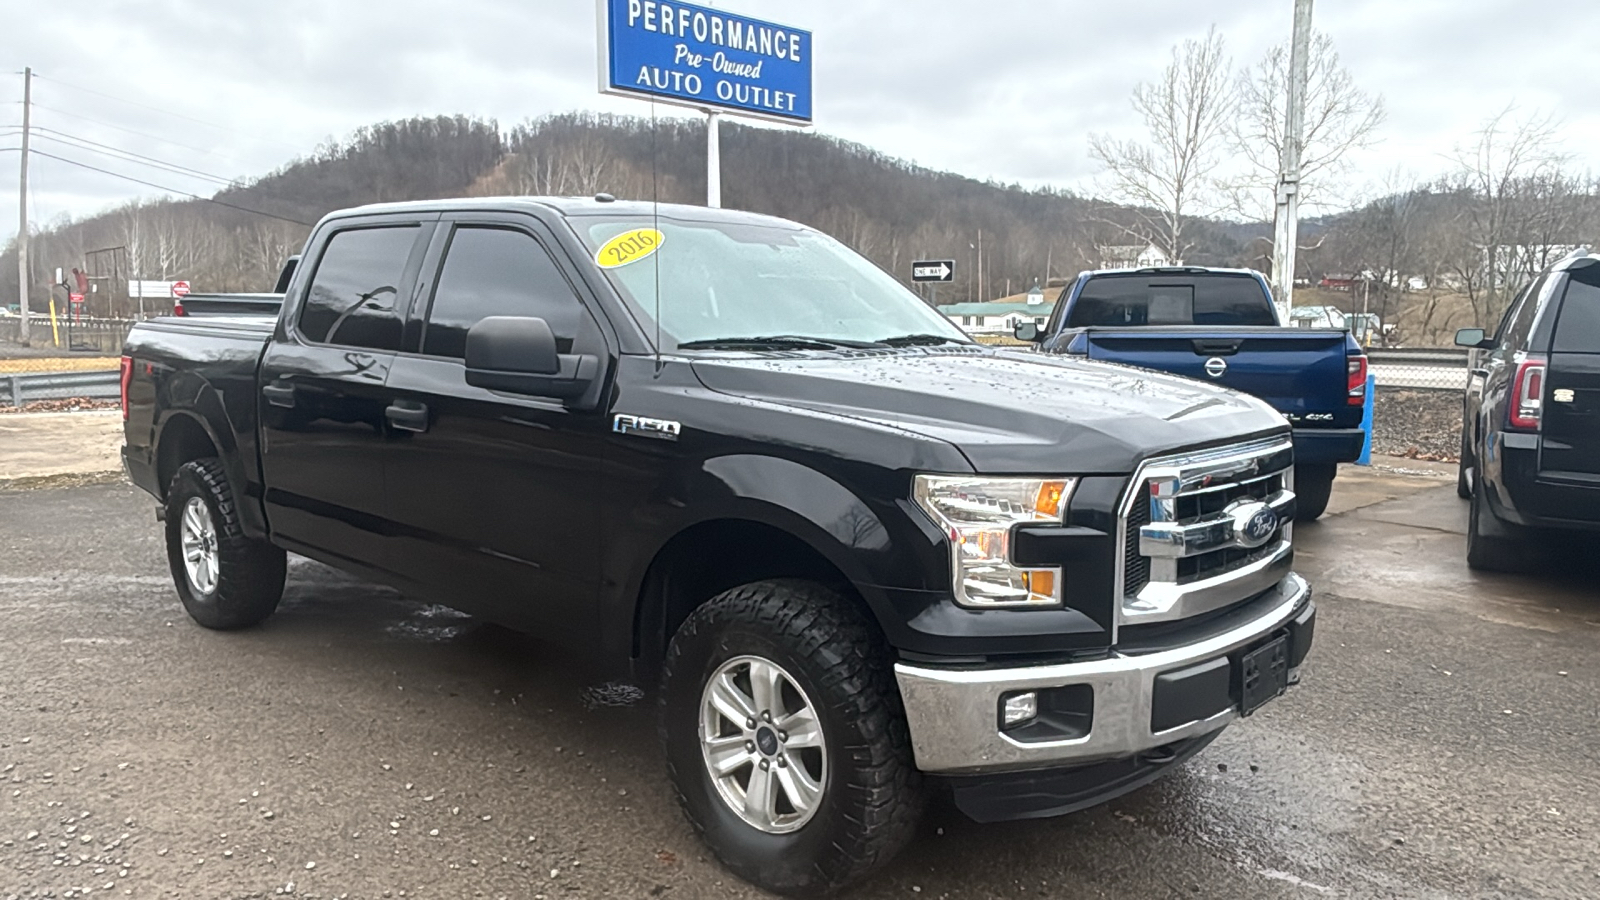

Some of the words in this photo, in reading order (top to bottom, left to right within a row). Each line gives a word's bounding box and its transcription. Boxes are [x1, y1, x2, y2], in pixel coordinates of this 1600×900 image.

[628, 0, 801, 62] PERFORMANCE
[674, 43, 763, 78] Pre-Owned
[636, 65, 702, 95] AUTO
[716, 79, 797, 111] OUTLET
[608, 231, 654, 262] 2016
[914, 267, 926, 276] ONE
[929, 267, 942, 276] WAY
[1253, 513, 1273, 537] Ford
